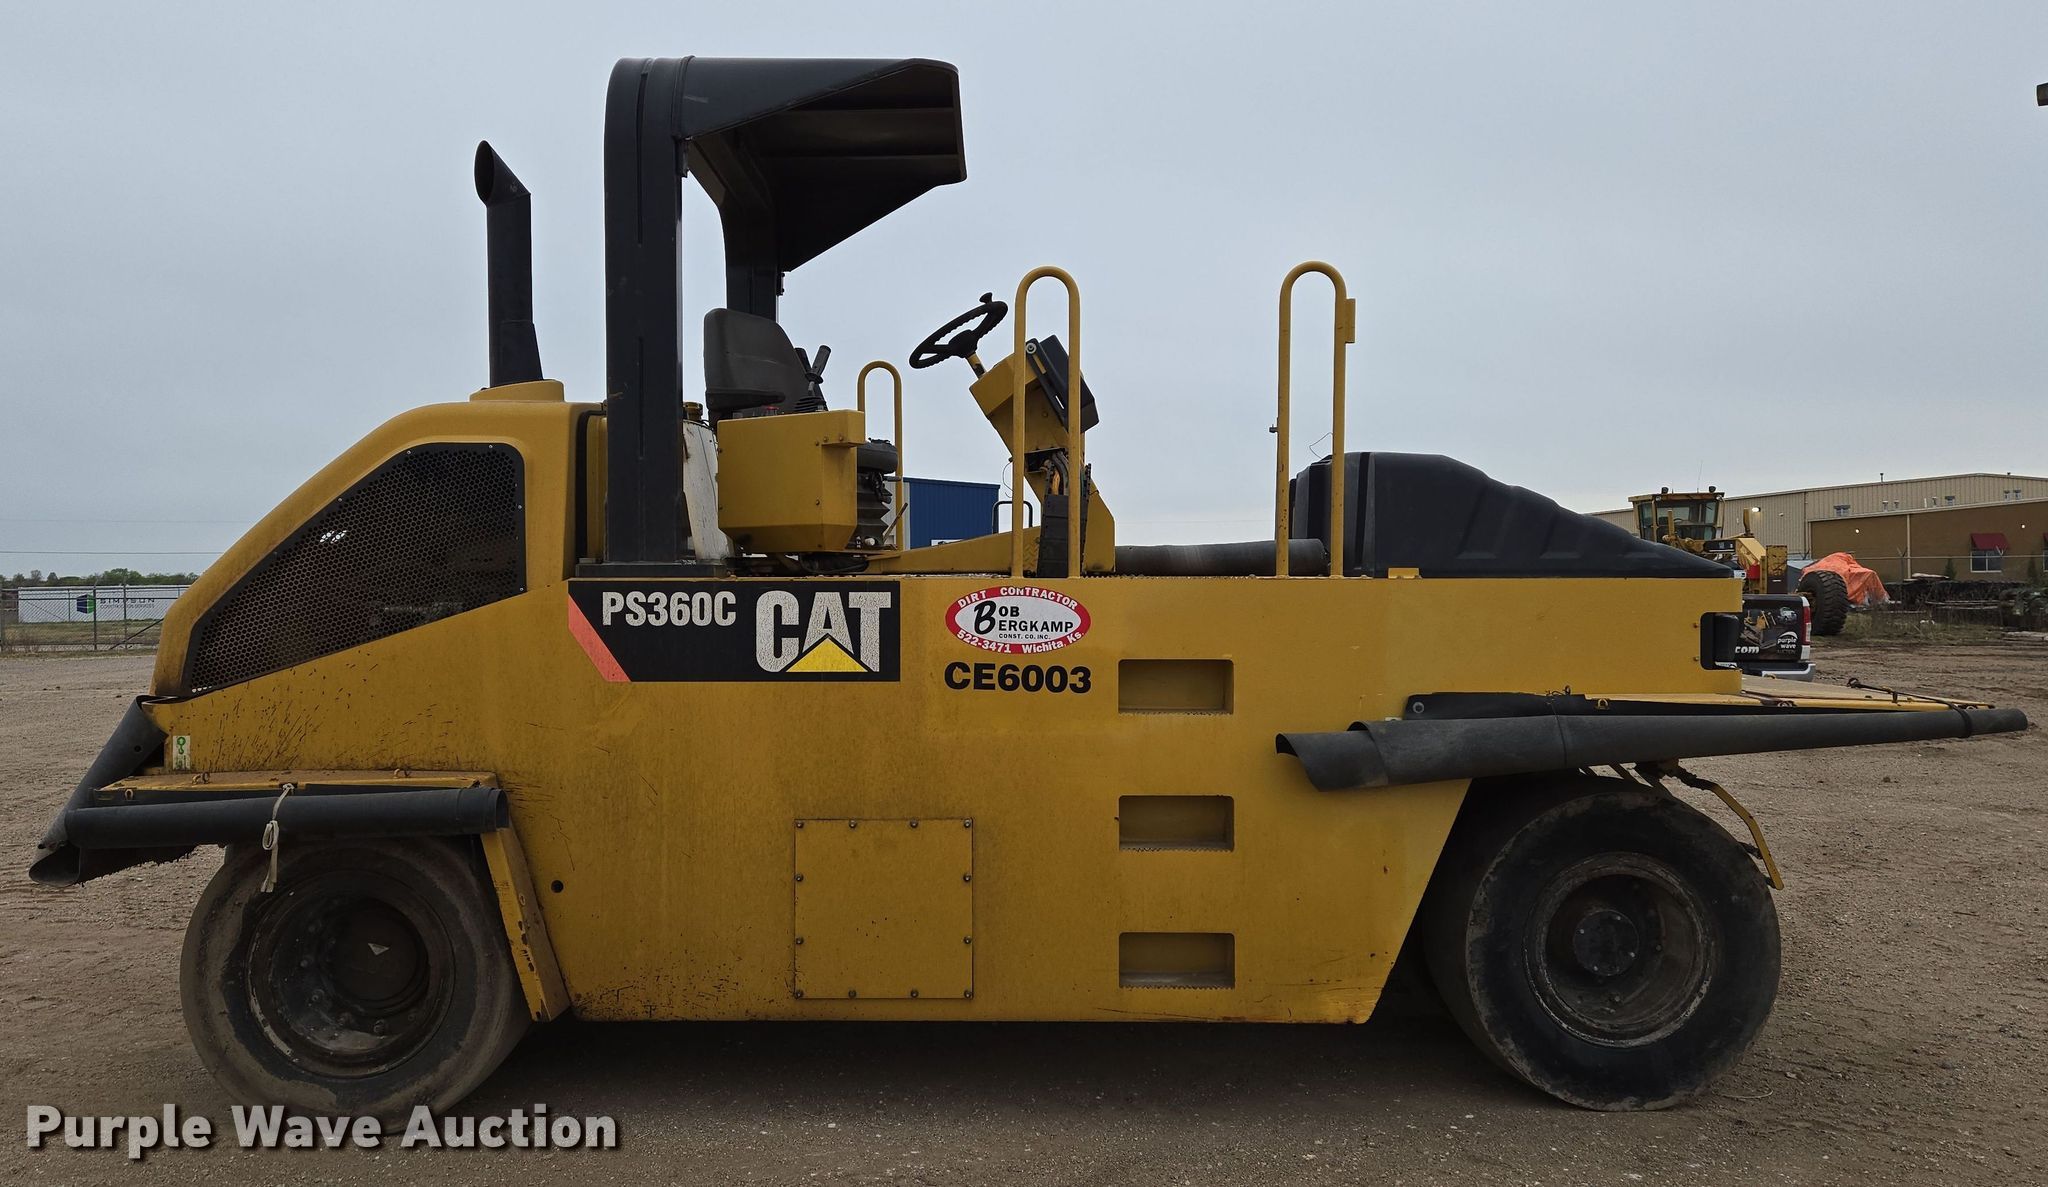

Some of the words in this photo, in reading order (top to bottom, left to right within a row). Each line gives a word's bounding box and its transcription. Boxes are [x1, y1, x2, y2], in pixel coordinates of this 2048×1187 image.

[602, 590, 736, 627] PS360C
[957, 590, 987, 608] DIRT
[1000, 587, 1078, 610] CONTRACTOR
[756, 590, 891, 672] CAT
[956, 629, 1012, 653] 522-3471
[944, 662, 1092, 693] CE6003
